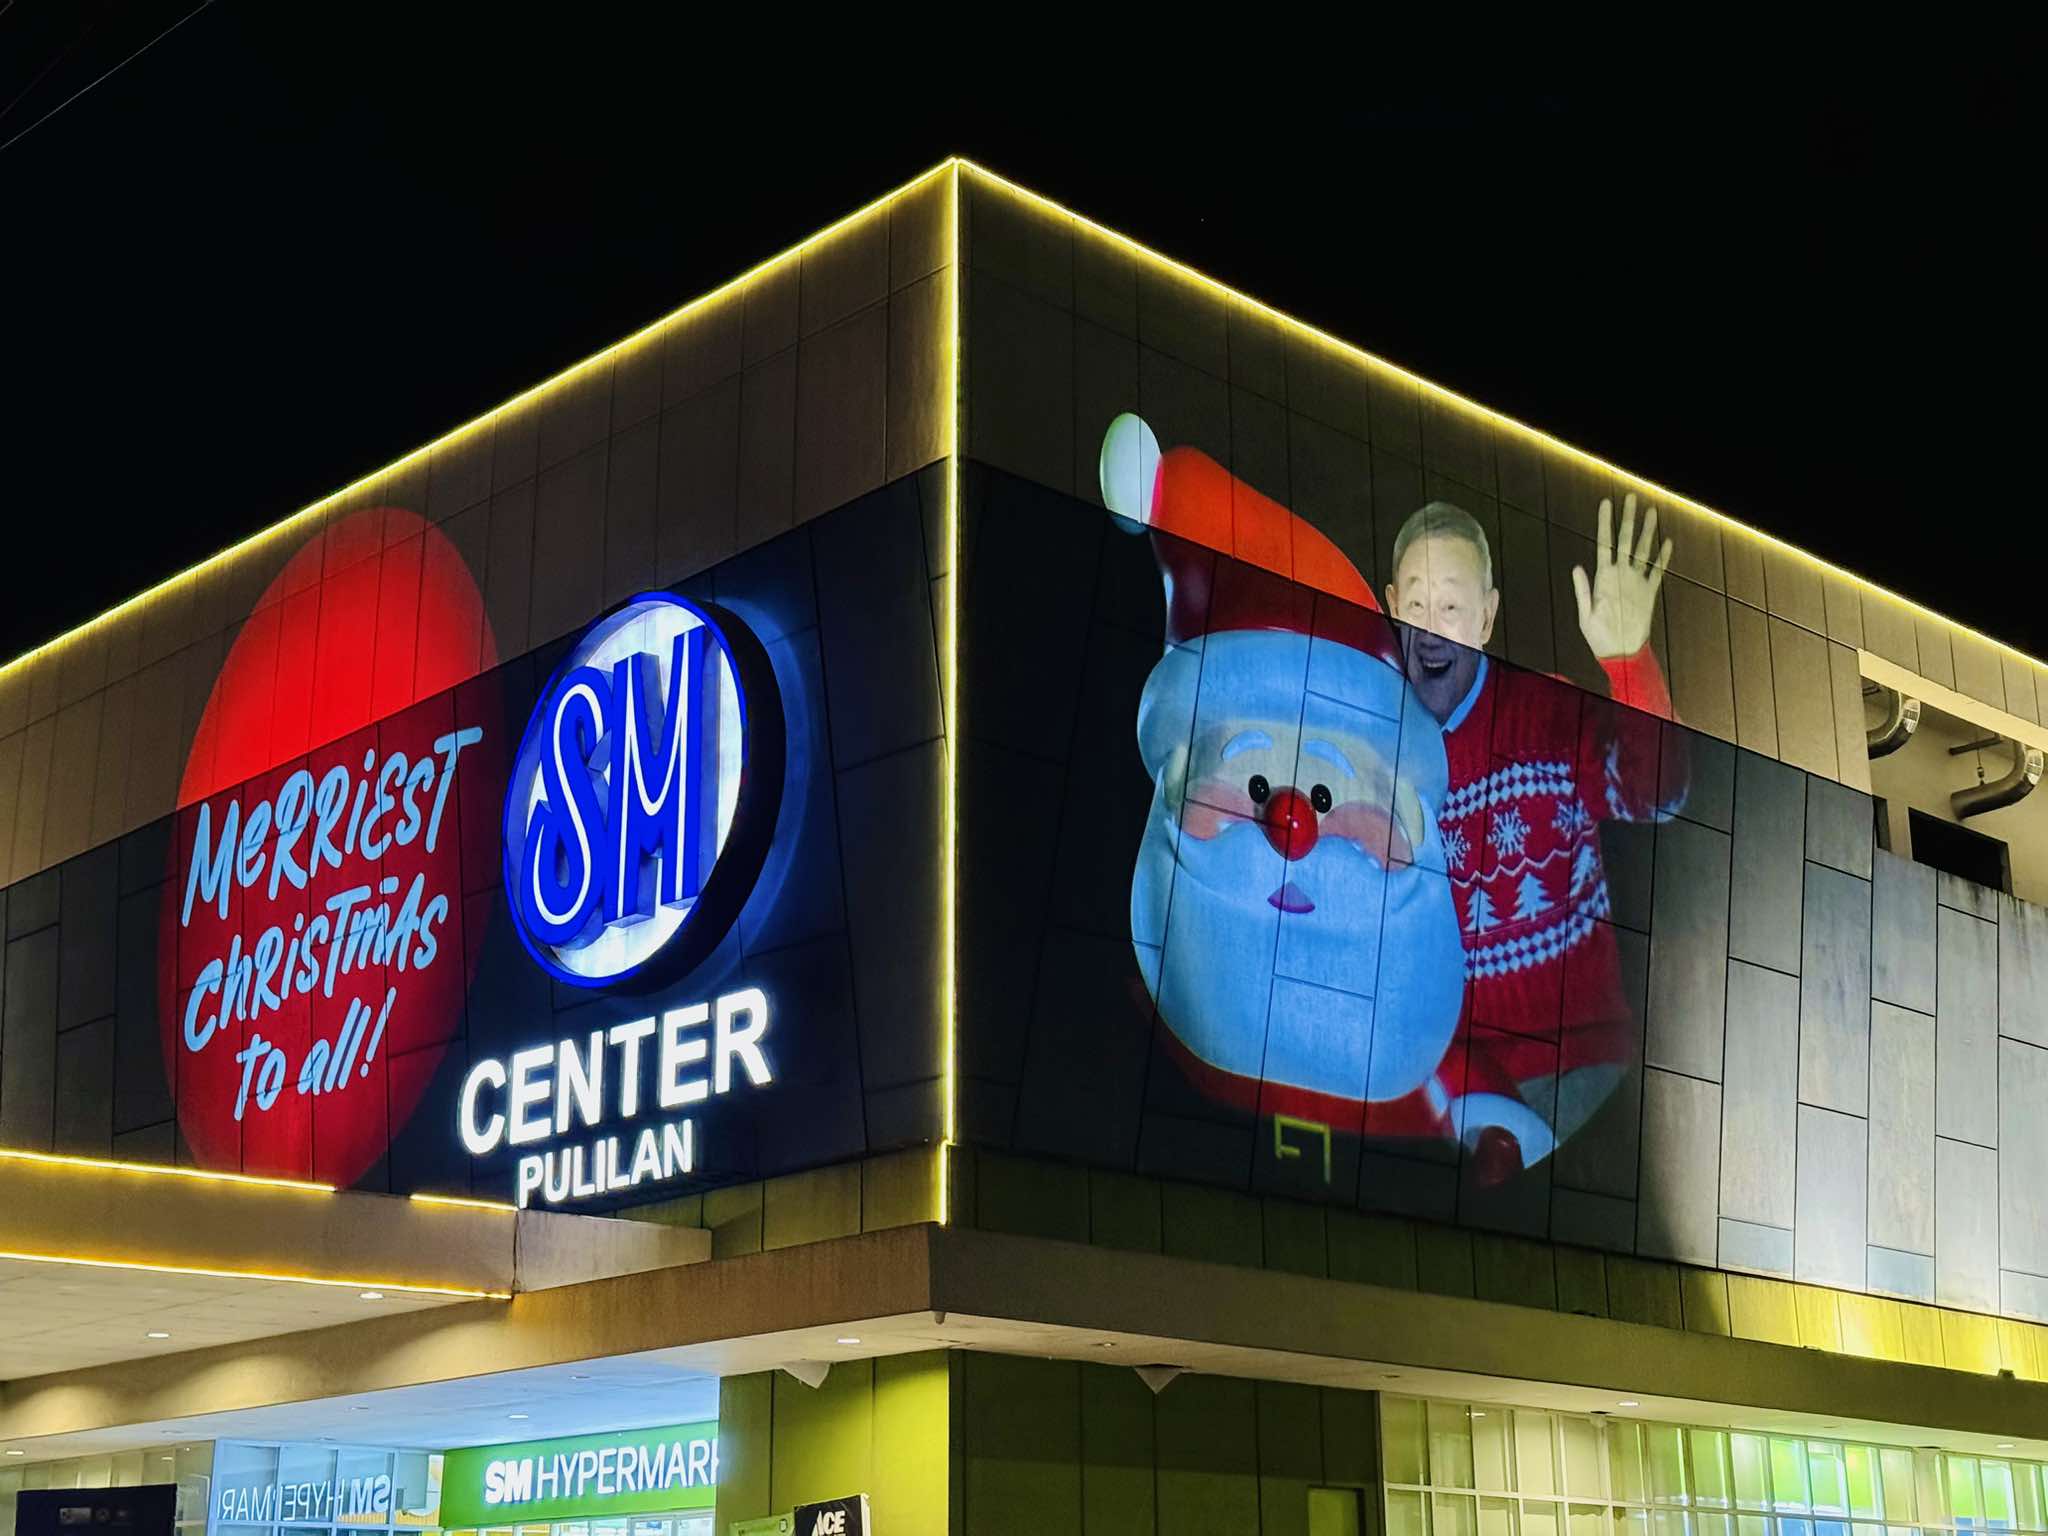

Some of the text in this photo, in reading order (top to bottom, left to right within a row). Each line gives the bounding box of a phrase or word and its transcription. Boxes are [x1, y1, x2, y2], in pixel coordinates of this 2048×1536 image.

[520, 624, 706, 948] SM
[297, 986, 396, 1096] all!
[457, 987, 773, 1157] CENTER
[517, 1118, 694, 1209] PULILAN
[484, 1458, 533, 1504] SM
[811, 1510, 846, 1535] ACE
